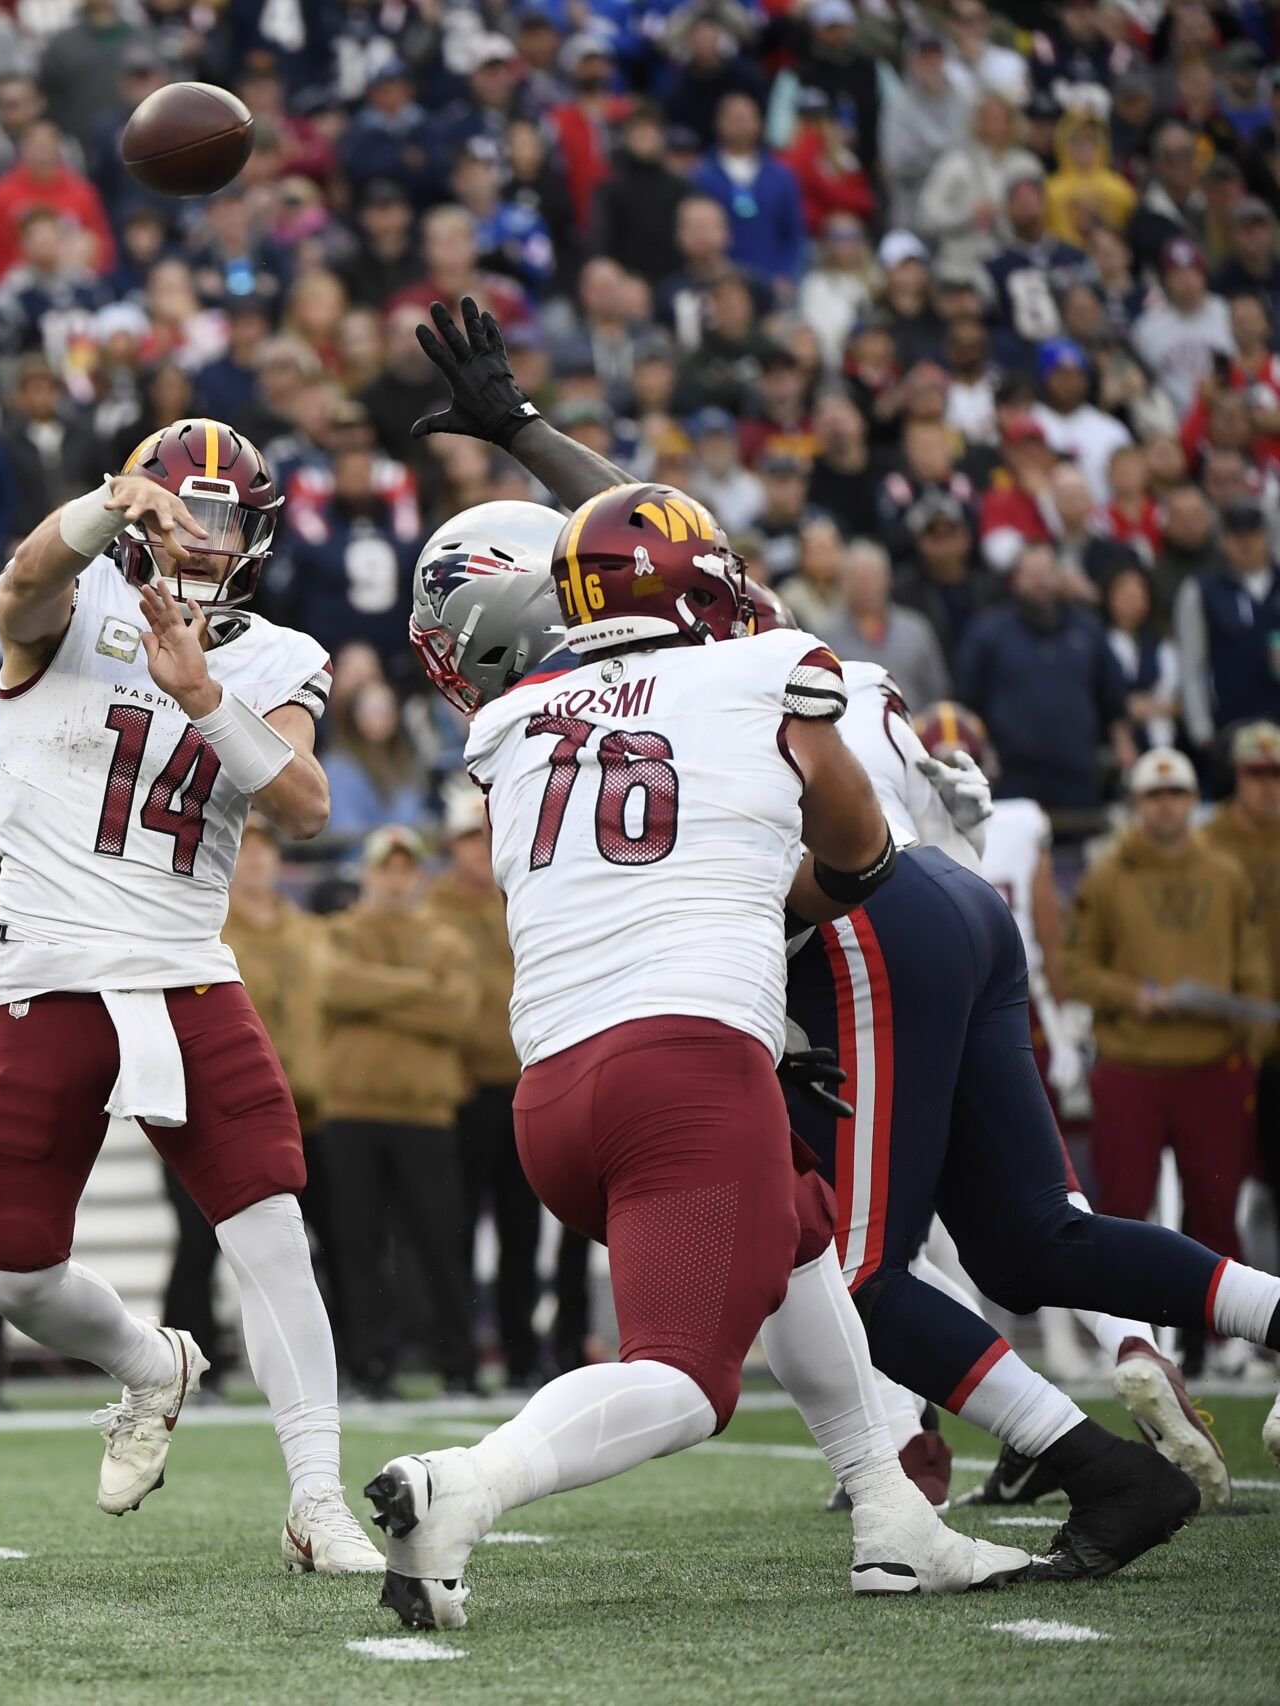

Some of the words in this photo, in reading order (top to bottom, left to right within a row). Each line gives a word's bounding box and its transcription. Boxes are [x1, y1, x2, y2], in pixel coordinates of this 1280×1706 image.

[344, 536, 398, 614] 9
[102, 620, 140, 652] C
[113, 683, 184, 713] WASHI
[543, 675, 658, 718] GOSMI
[93, 703, 222, 878] 14
[524, 713, 680, 873] 76
